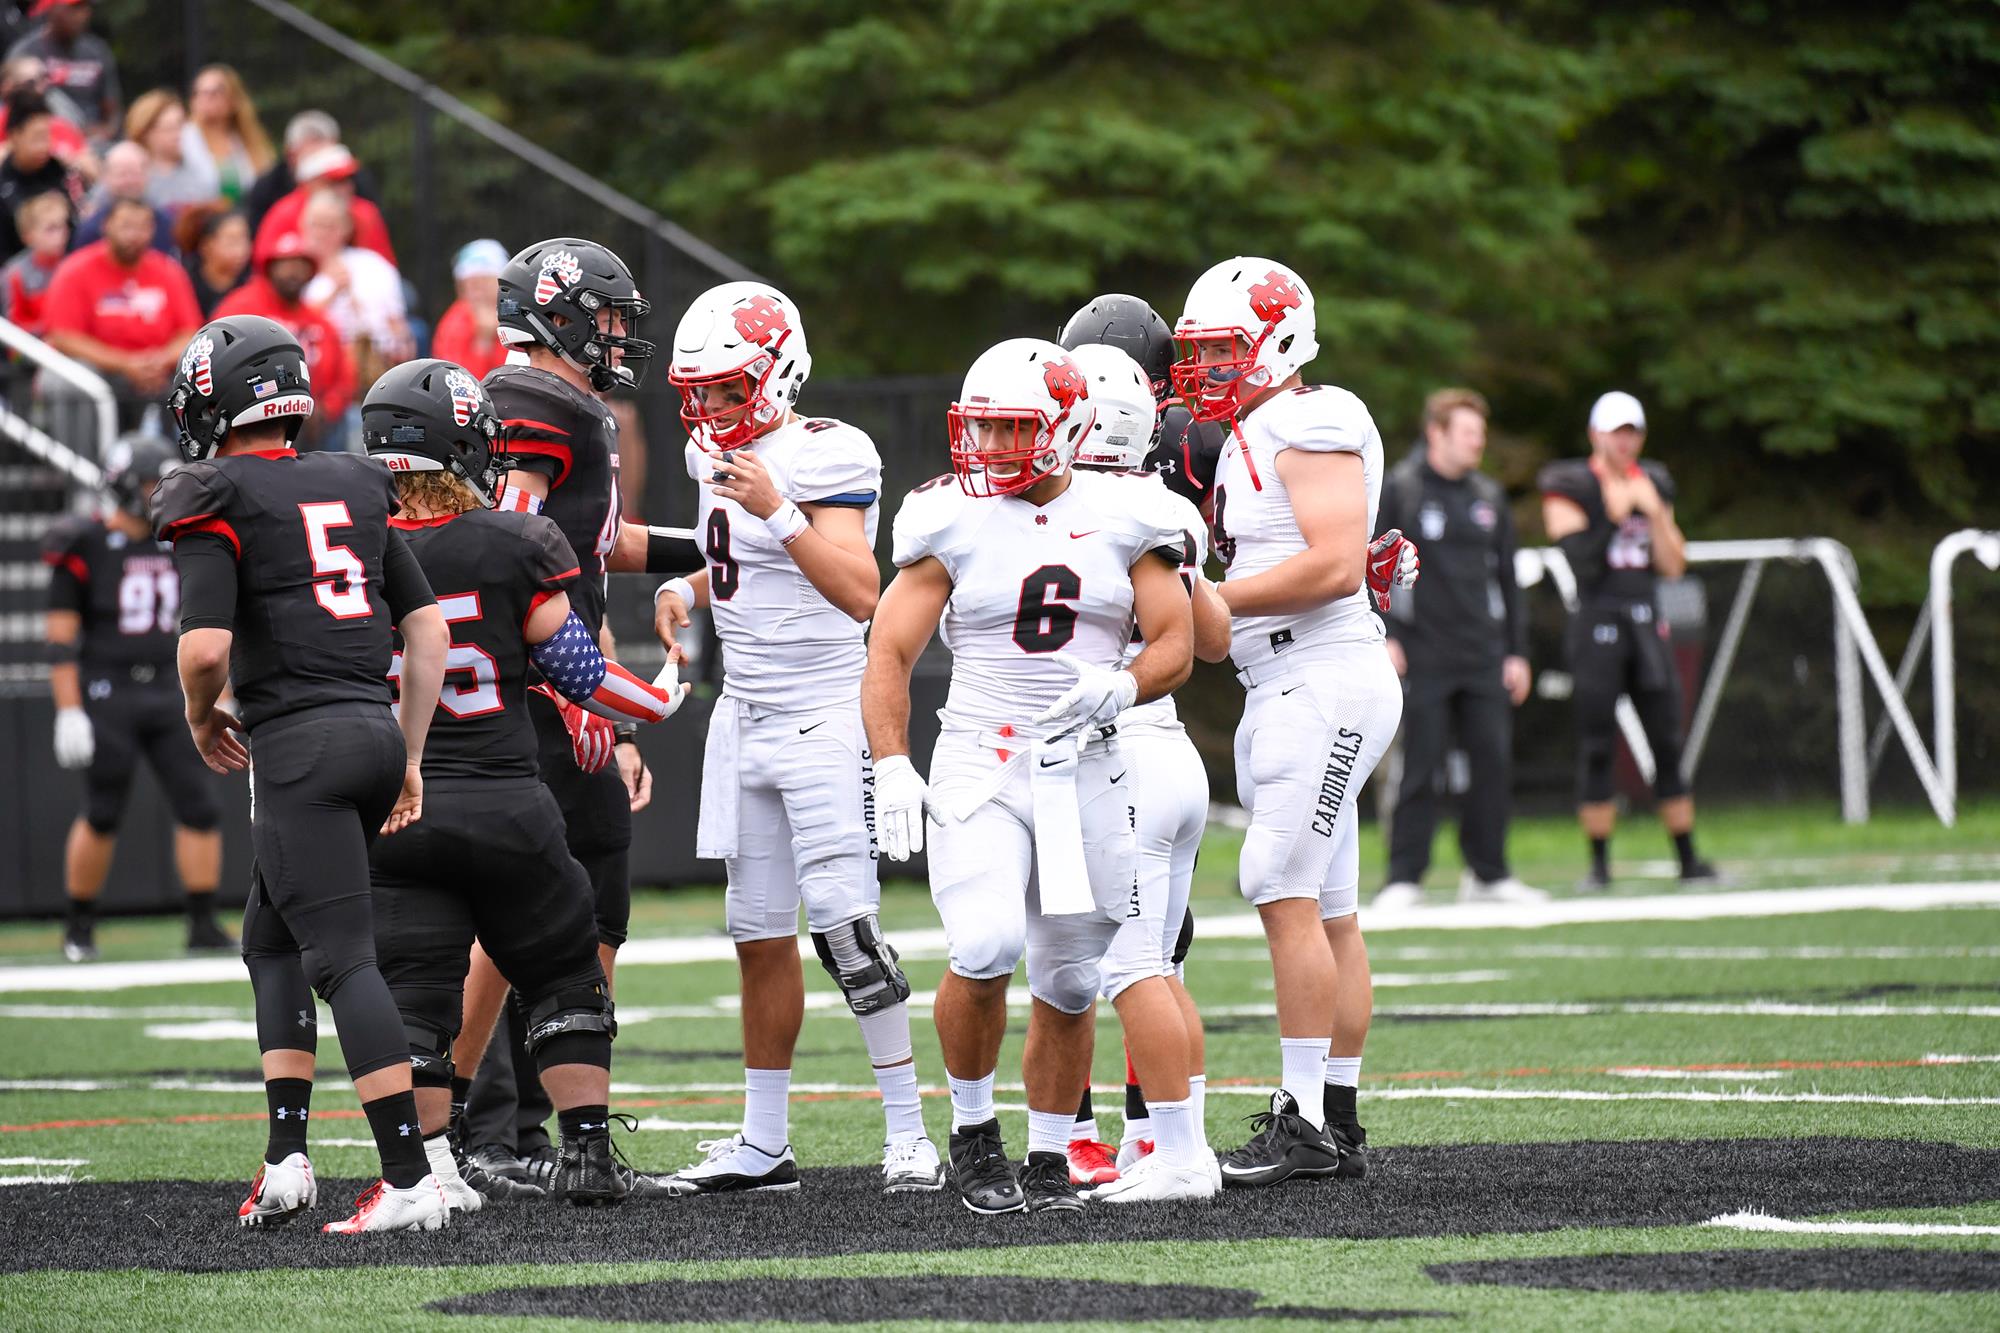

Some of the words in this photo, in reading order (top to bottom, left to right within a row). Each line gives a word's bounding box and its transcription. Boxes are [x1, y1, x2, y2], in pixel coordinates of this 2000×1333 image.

[263, 400, 312, 417] Riddell
[298, 500, 374, 620] 5
[706, 507, 740, 601] 9
[385, 590, 505, 719] 5
[1012, 564, 1082, 654] 6
[1311, 727, 1363, 838] CARDINALS
